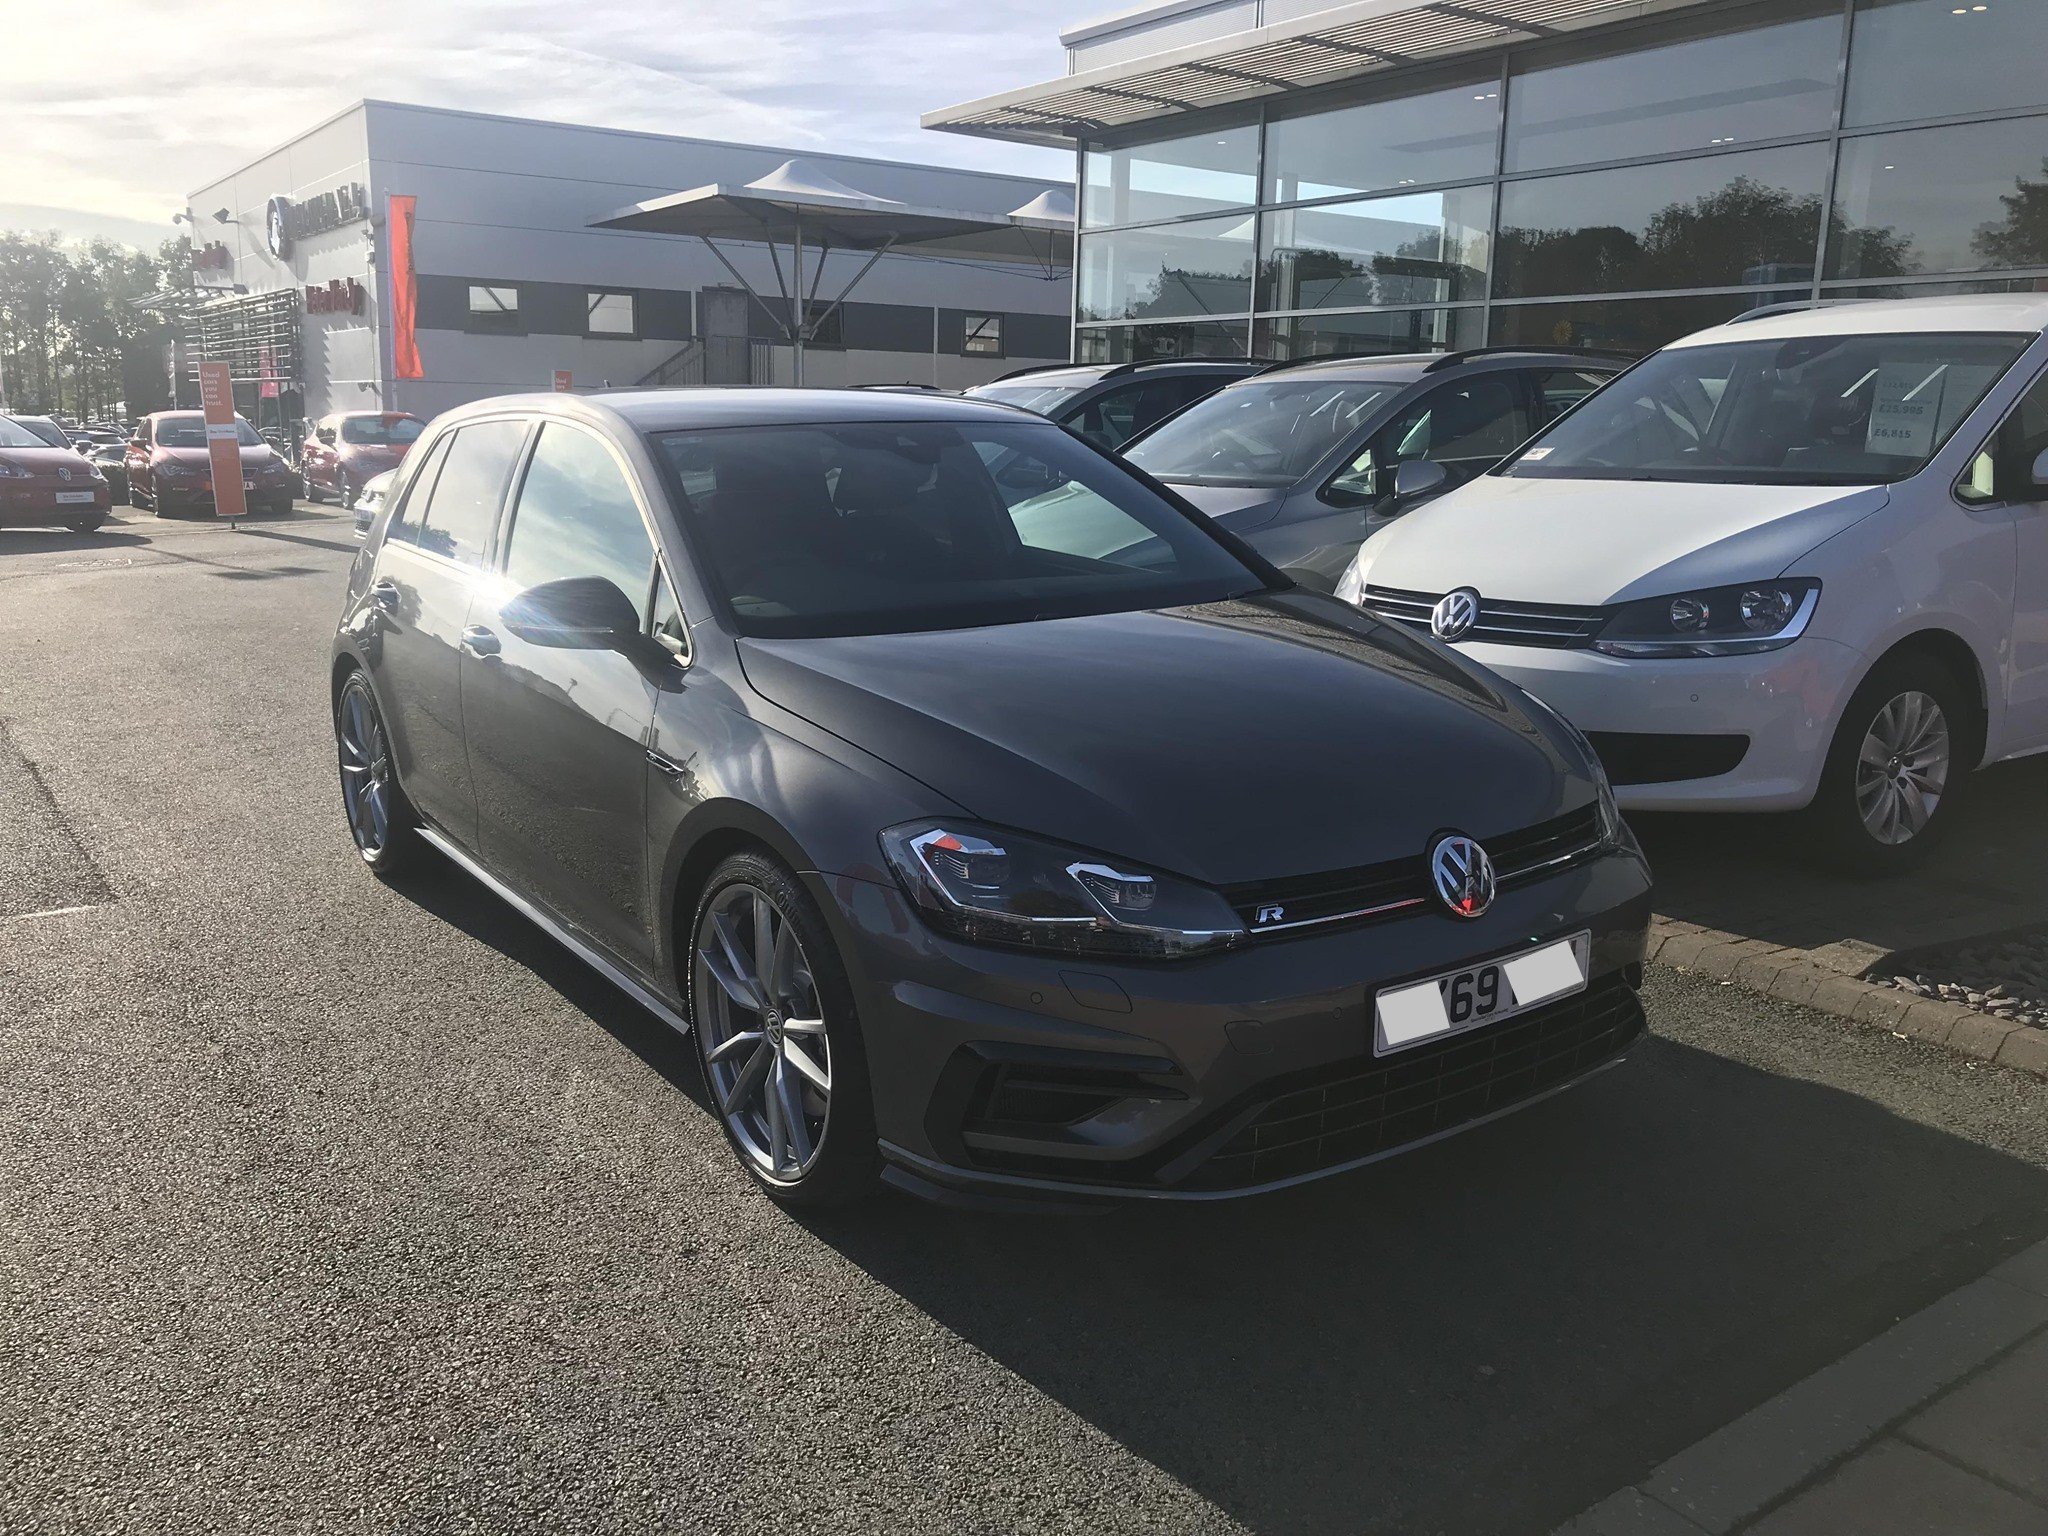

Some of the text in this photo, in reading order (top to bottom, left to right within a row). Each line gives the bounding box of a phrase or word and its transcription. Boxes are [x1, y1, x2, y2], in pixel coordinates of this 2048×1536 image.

[1879, 404, 1924, 415] £25,995
[1874, 428, 1912, 439] £6,815
[1255, 903, 1285, 923] R
